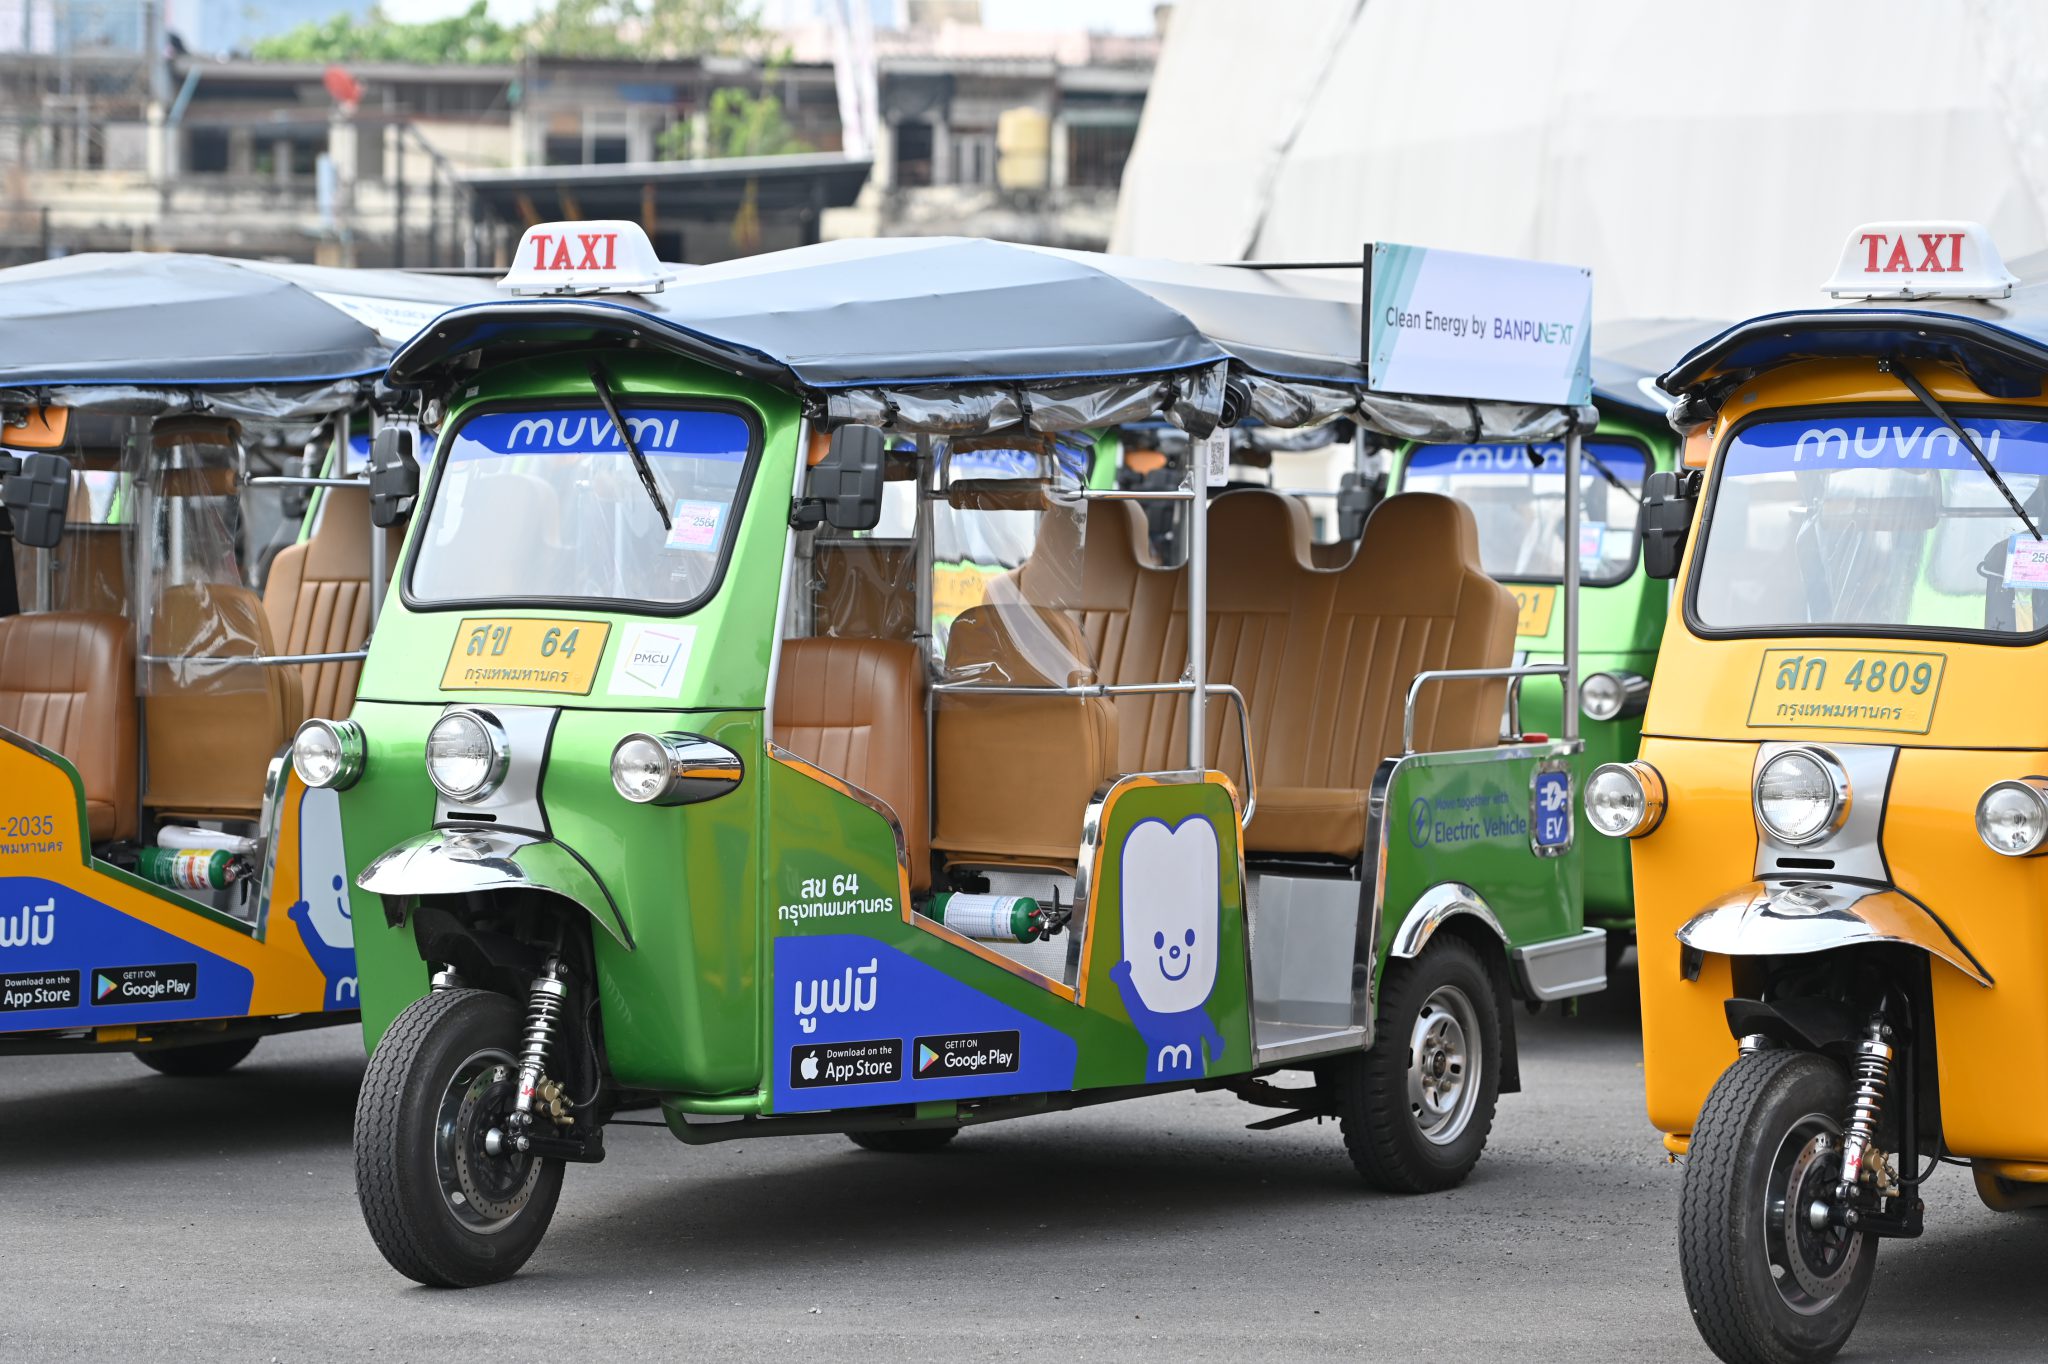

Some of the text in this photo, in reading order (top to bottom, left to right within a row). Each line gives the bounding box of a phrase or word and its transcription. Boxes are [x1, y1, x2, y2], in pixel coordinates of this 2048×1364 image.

[530, 234, 618, 270] TAXI
[1860, 233, 1965, 272] TAXI
[1386, 306, 1421, 329] Clean
[1425, 310, 1468, 336] Energy
[1472, 315, 1487, 338] by
[506, 417, 679, 449] muvmi
[1793, 426, 2000, 462] muvmi
[692, 516, 715, 528] 2564
[466, 624, 580, 658] สข 64
[633, 653, 670, 664] PMCU
[464, 668, 569, 685] กรุงเทพมหานคร
[1776, 655, 1932, 695] สก 4809
[1776, 702, 1902, 721] กรุงเทพมหานคร
[1435, 814, 1526, 843] Electric Vehicle
[1545, 817, 1563, 839] EV
[801, 873, 859, 899] สข 64
[778, 897, 893, 927] กรุงเทพมหานคร
[5, 977, 44, 987] Download
[57, 976, 70, 984] the
[123, 970, 156, 980] GET IT ON
[3, 988, 71, 1008] App Store
[122, 979, 190, 998] Google Play
[794, 957, 878, 1034] มูฟมี
[826, 1045, 892, 1059] Download on the
[945, 1039, 978, 1049] GET IT ON
[825, 1059, 893, 1082] App Store
[944, 1049, 1013, 1070] Google Play
